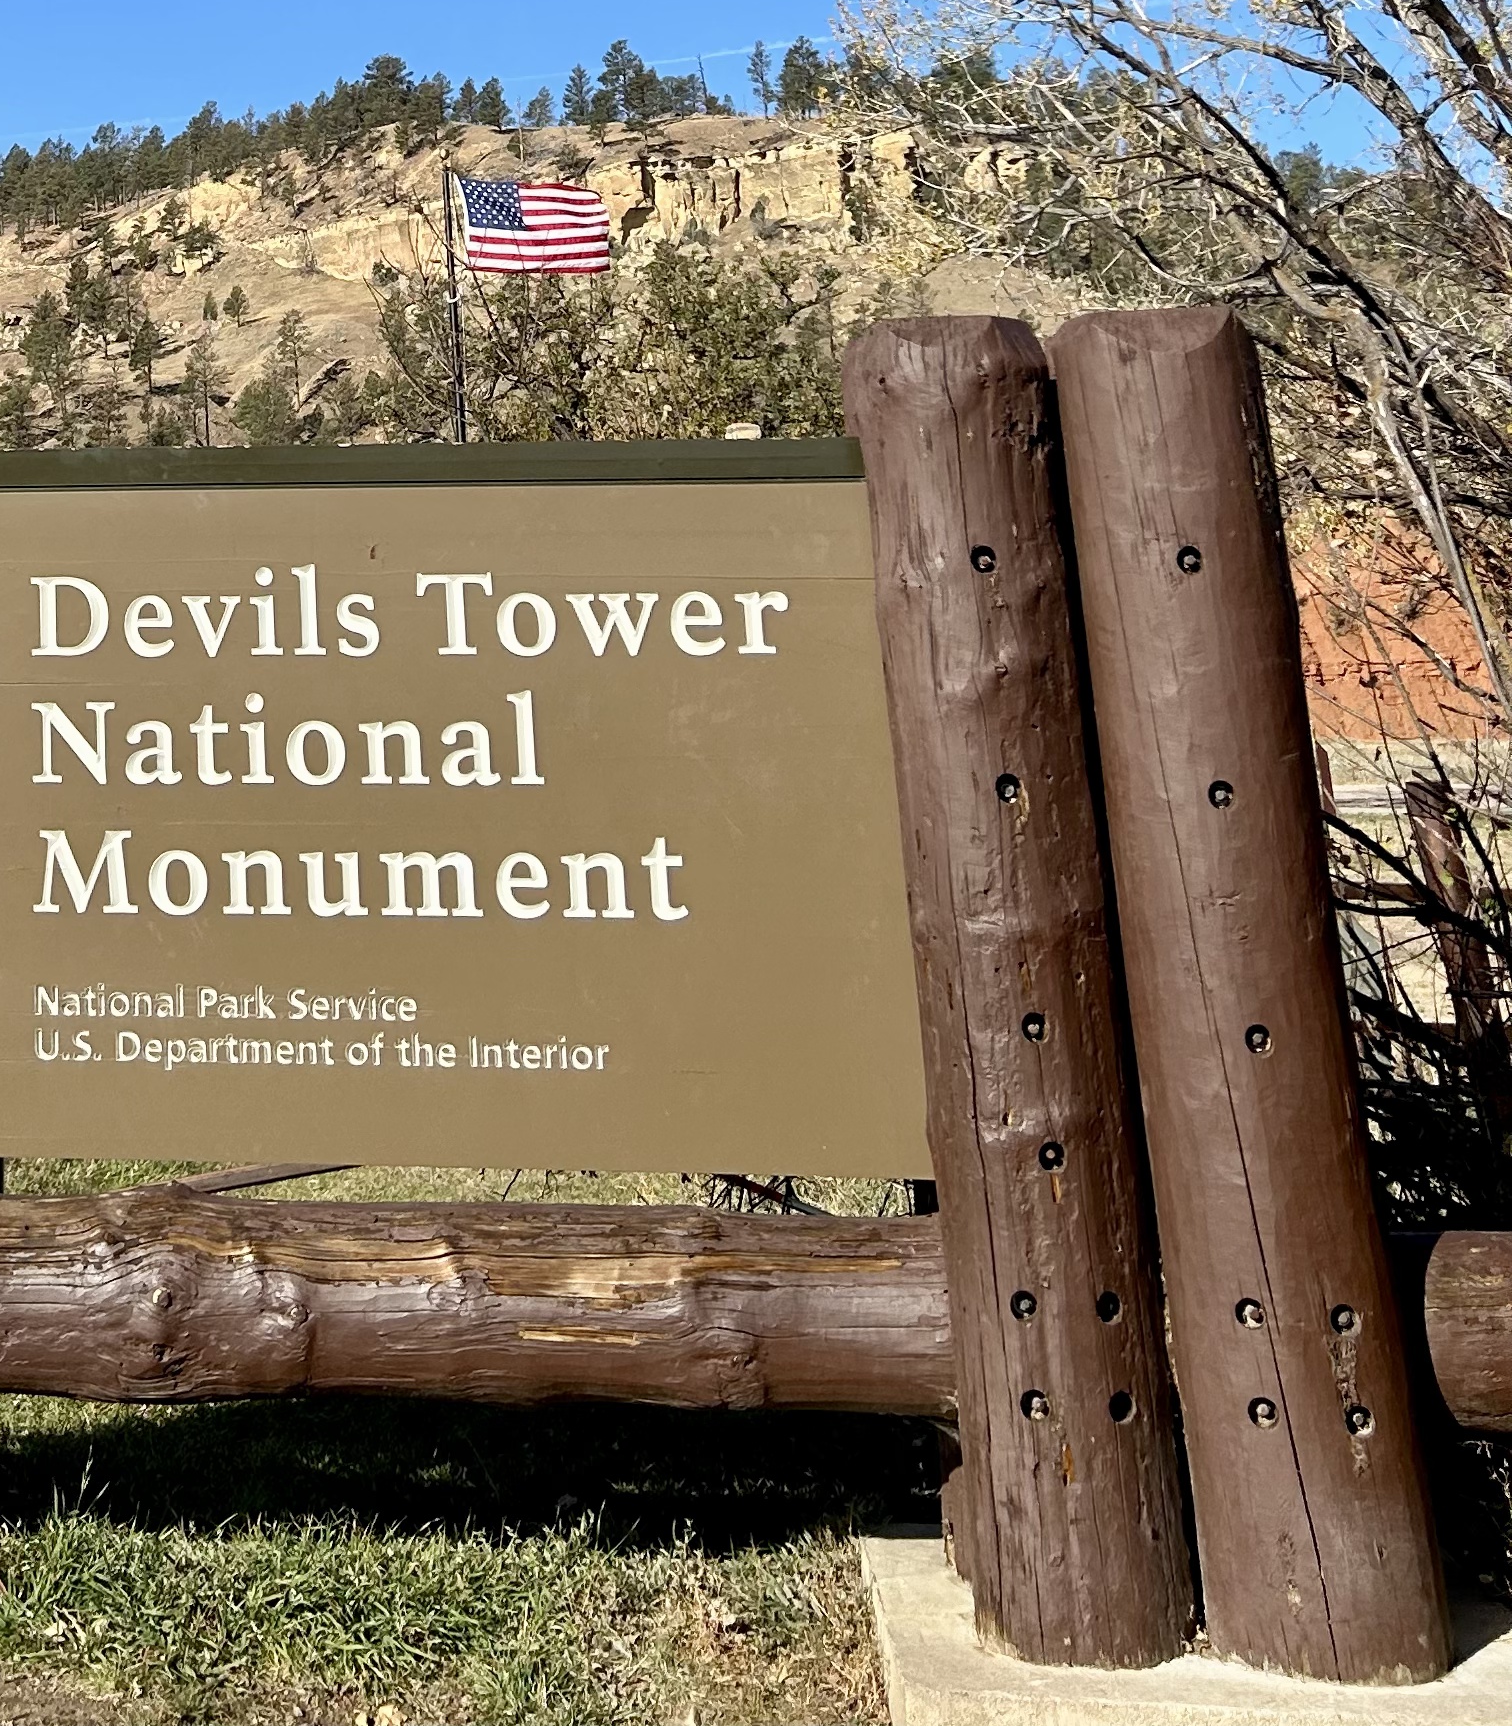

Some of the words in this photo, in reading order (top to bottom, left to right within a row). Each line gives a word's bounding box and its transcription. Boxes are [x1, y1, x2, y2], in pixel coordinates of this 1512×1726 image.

[30, 563, 380, 658] Devils
[416, 571, 789, 657] Tower
[31, 689, 545, 787] National
[32, 829, 689, 921] Monument
[34, 982, 185, 1018] National
[197, 985, 277, 1019] Park
[287, 987, 418, 1022] Service
[34, 1027, 102, 1062] U.S.
[115, 1031, 335, 1071] Department
[345, 1031, 385, 1066] of
[394, 1032, 457, 1068] the
[469, 1035, 610, 1070] Interior
